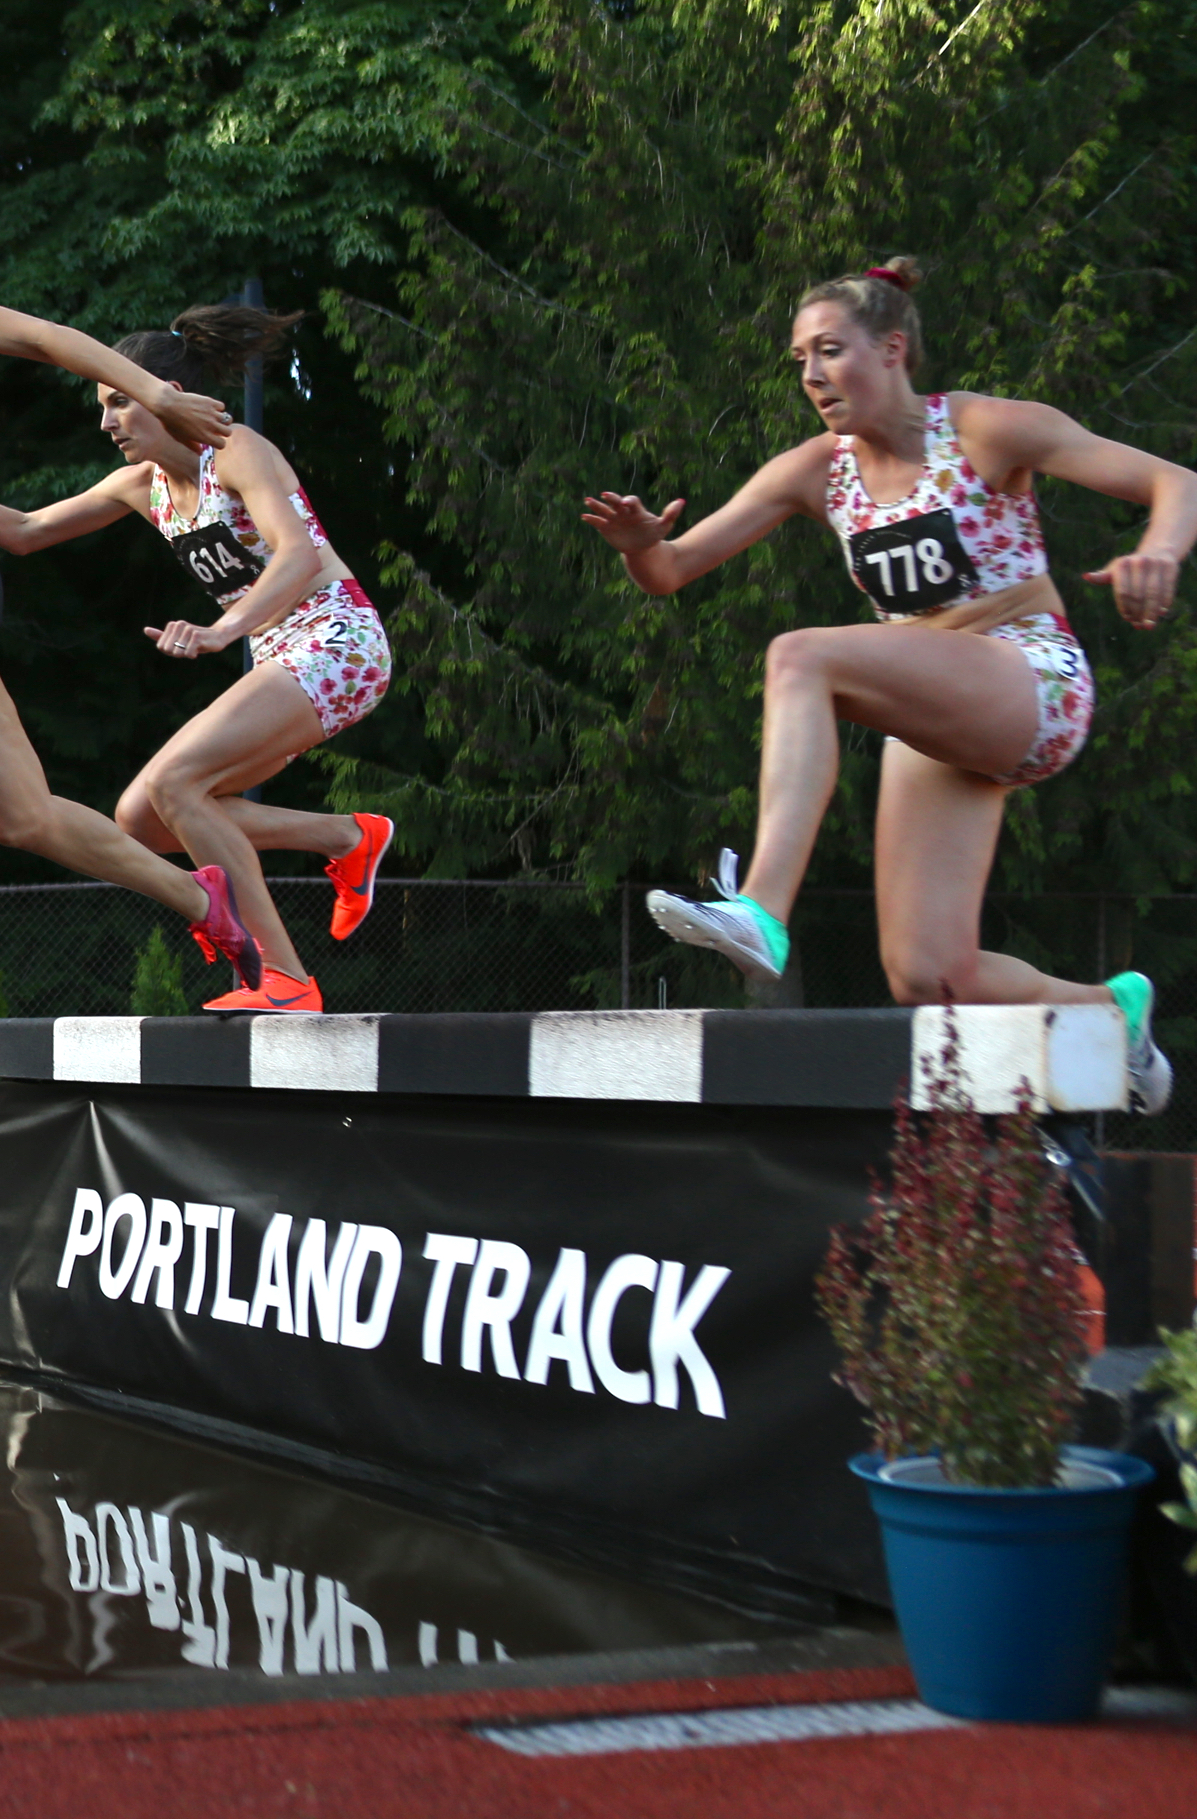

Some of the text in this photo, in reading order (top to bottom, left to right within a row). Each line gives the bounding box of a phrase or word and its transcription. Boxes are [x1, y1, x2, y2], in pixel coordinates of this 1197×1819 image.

[189, 541, 245, 583] 614
[864, 537, 954, 597] 778
[324, 620, 348, 645] 2
[56, 1187, 733, 1420] PORTLAND TRACK
